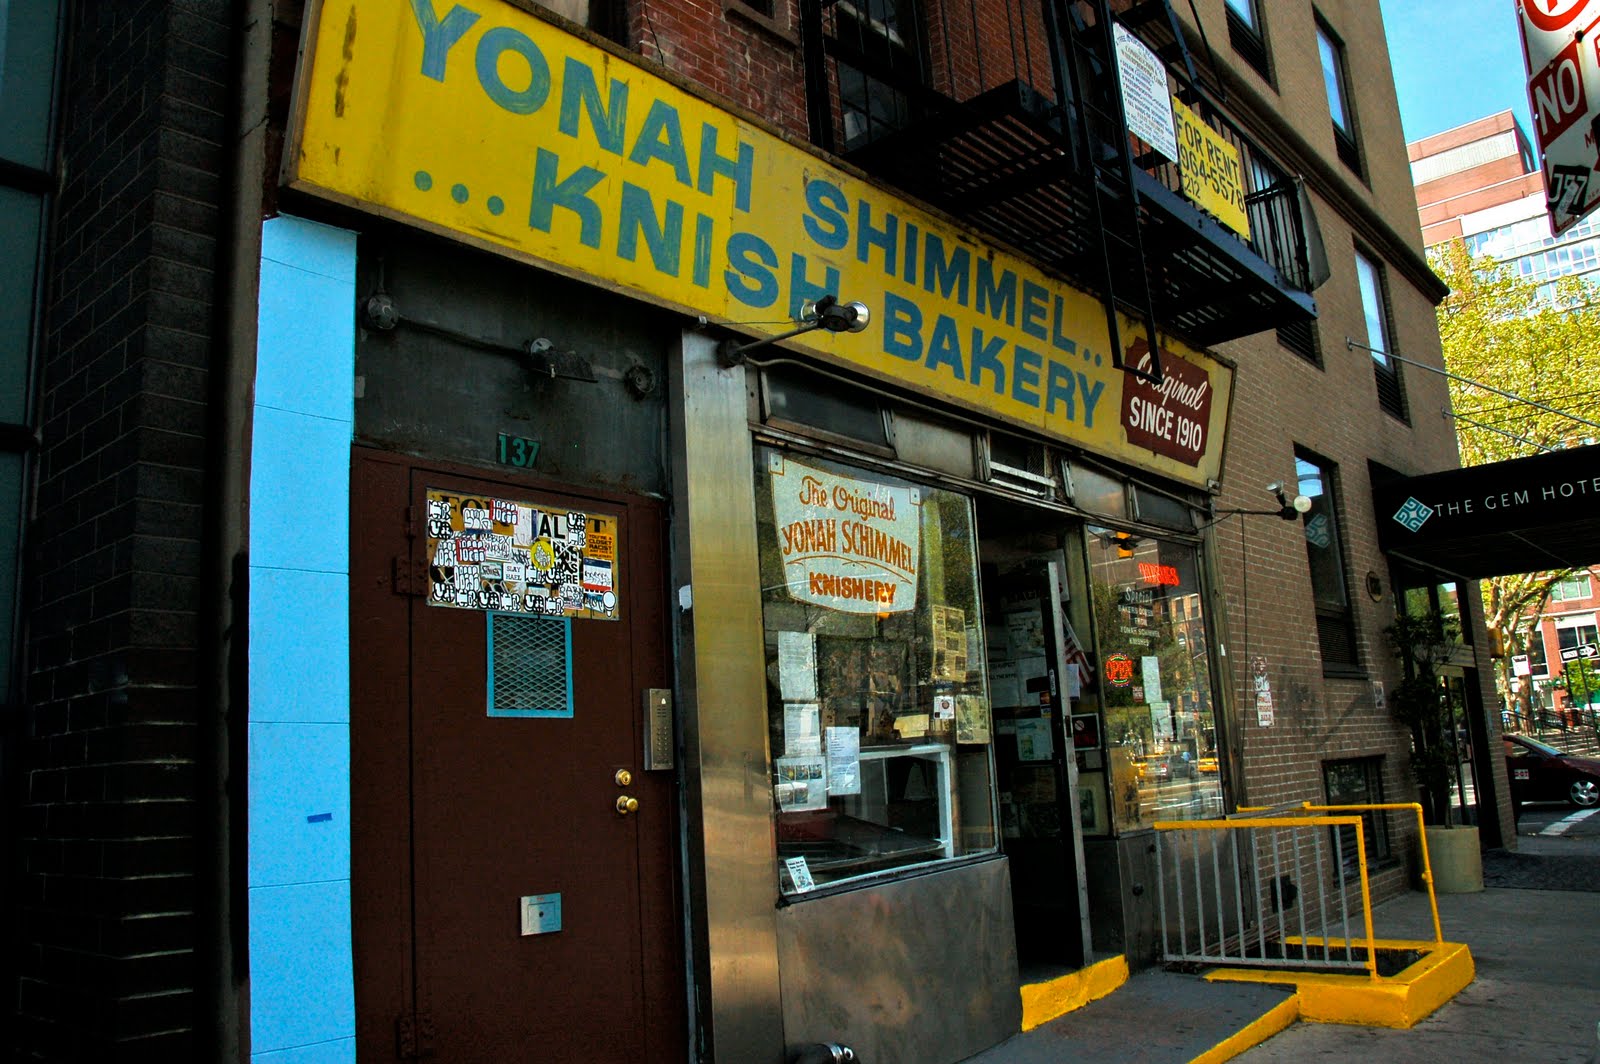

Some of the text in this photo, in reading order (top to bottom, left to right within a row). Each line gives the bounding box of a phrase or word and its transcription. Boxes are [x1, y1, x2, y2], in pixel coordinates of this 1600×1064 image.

[411, 0, 754, 213] YONAH
[1535, 59, 1580, 136] NO
[1175, 111, 1204, 149] FOR
[1206, 136, 1239, 185] RENT
[1180, 144, 1246, 214] 964-5578
[883, 291, 1106, 429] BAKERY
[1136, 352, 1208, 410] Oiginal
[499, 434, 540, 469] 137
[1129, 396, 1202, 451] SINCE 1910
[800, 475, 897, 522] The Original
[1434, 499, 1473, 517] THE
[1485, 490, 1530, 510] GEM
[781, 519, 915, 575] YONAH SCHIMMEL
[809, 571, 897, 604] KNISHERY
[1106, 660, 1133, 680] OPEN
